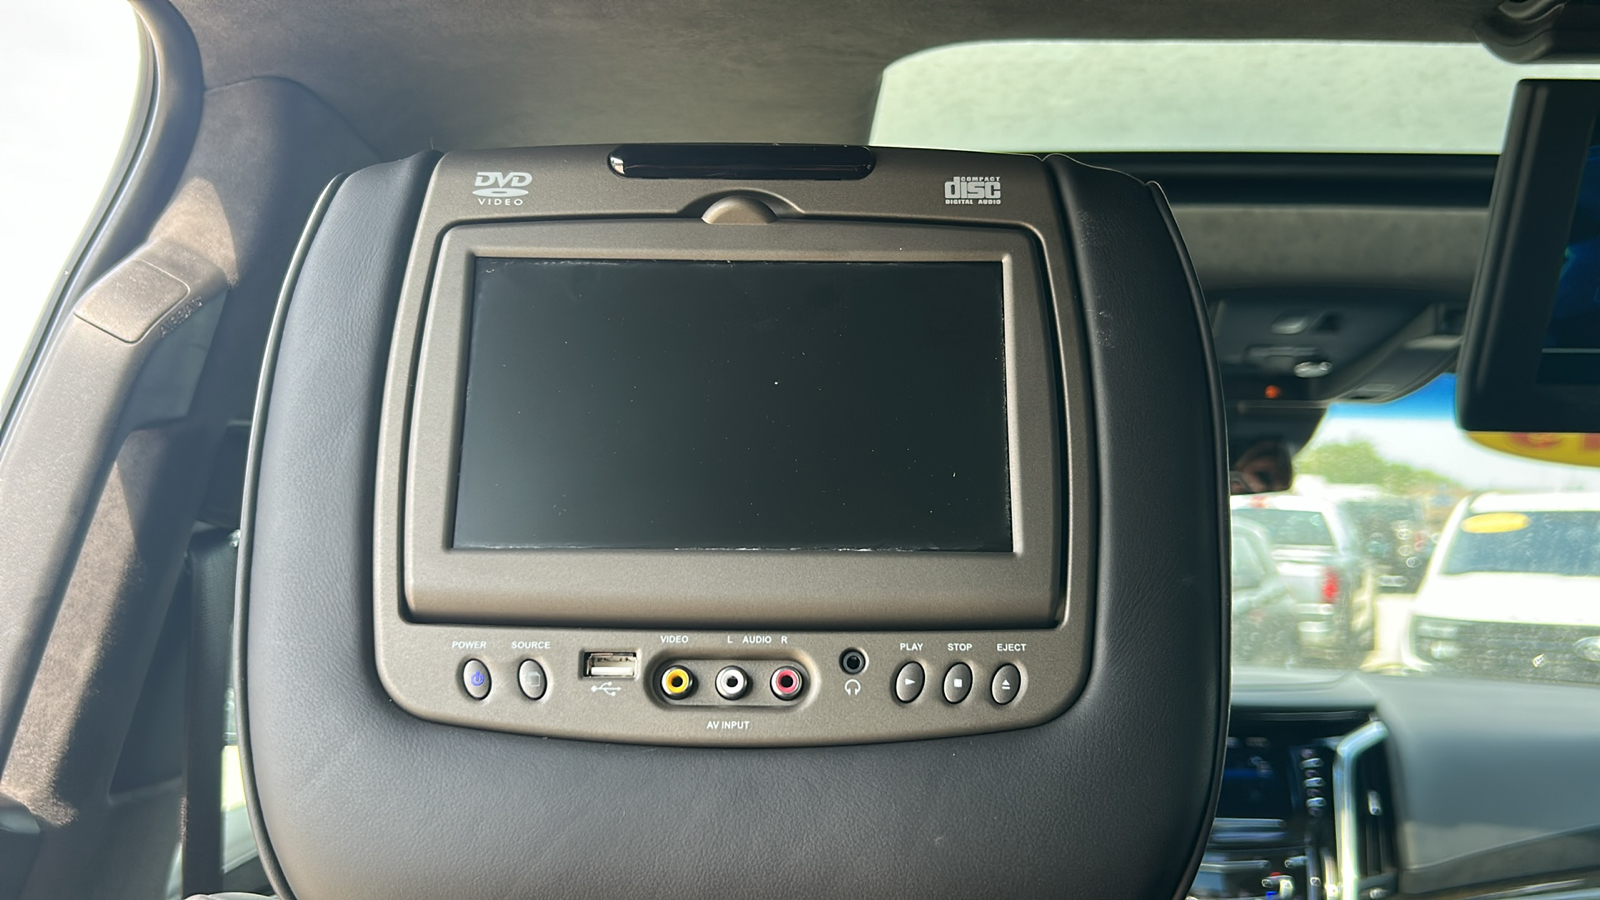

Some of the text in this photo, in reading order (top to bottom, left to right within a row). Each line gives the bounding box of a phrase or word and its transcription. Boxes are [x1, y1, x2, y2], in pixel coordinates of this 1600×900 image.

[474, 171, 533, 188] DVD
[944, 176, 1001, 199] disc
[478, 198, 524, 206] VIDEO
[158, 295, 203, 339] AIRBAG
[660, 635, 689, 644] VIDEO
[727, 635, 788, 644] L AUDIO R
[452, 641, 487, 649] POWER
[511, 641, 551, 650] SOURCE
[900, 642, 924, 651] PLAY
[947, 643, 973, 651] STOP
[996, 643, 1027, 652] EJECT
[706, 720, 750, 730] AV INPUT
